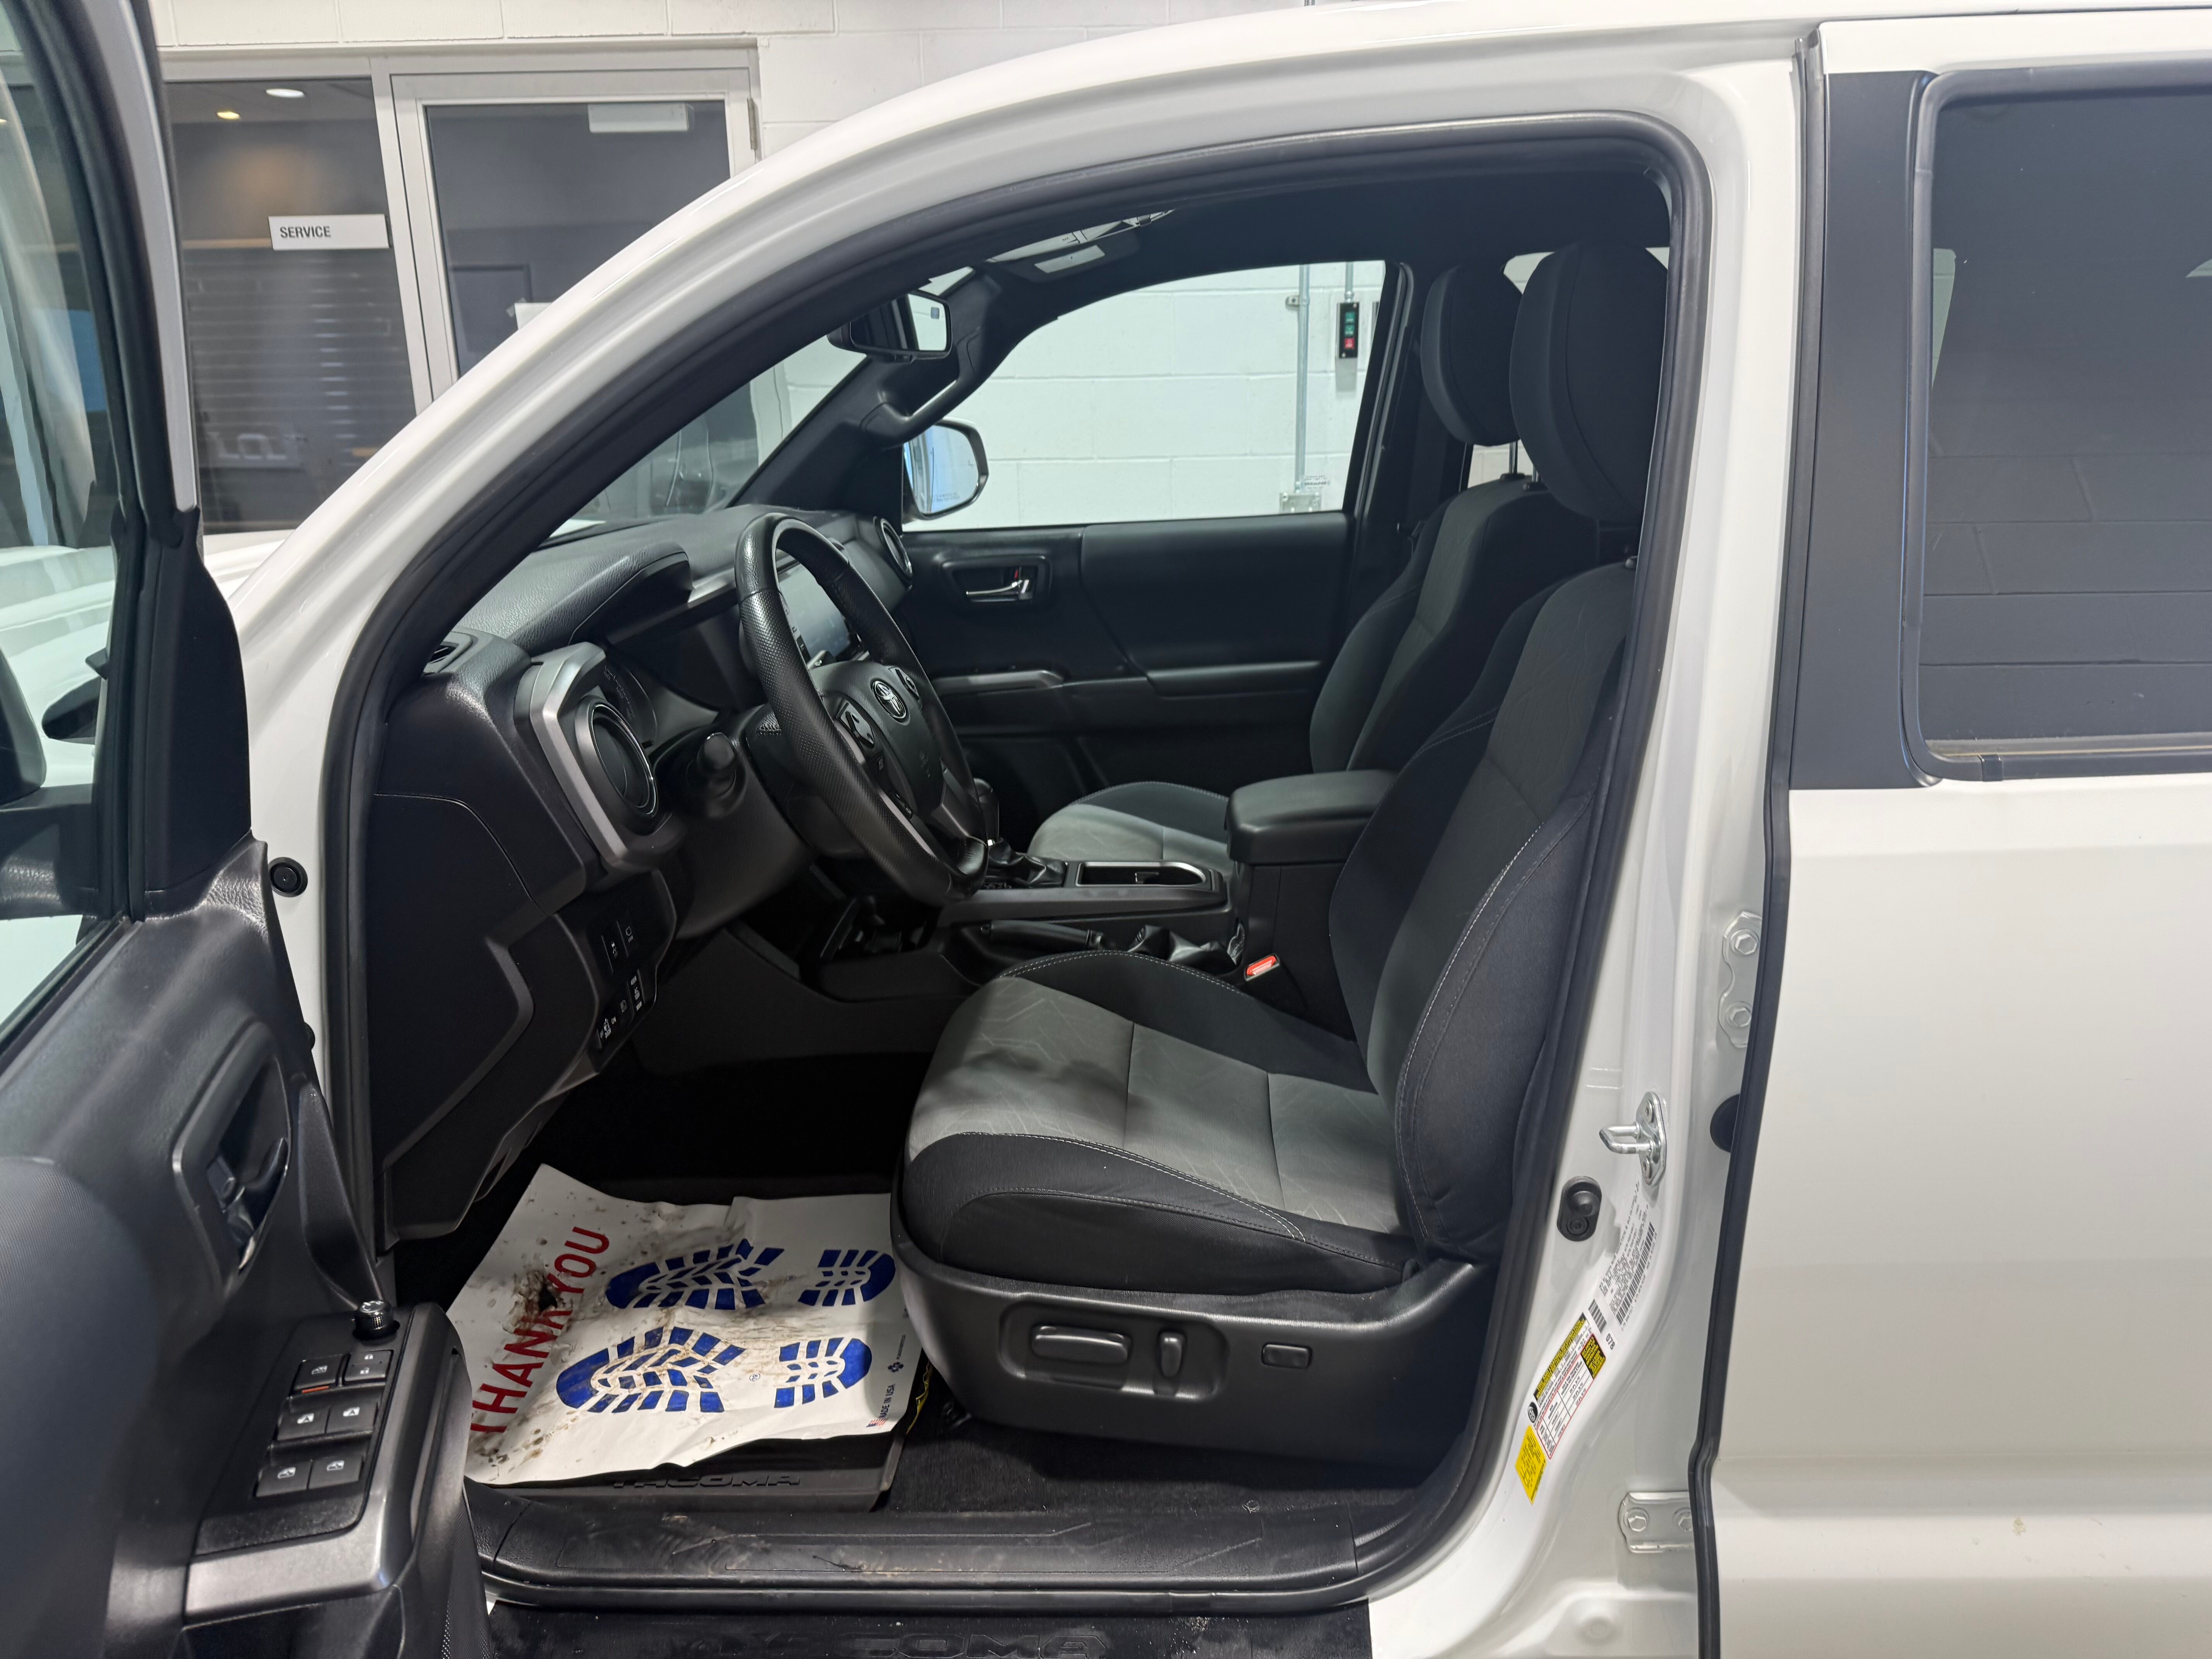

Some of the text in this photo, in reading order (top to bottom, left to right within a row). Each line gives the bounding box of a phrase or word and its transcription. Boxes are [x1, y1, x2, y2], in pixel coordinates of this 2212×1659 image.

[280, 226, 331, 238] SERVICE
[546, 1226, 610, 1294] YOU
[1606, 1333, 1615, 1350] 078
[878, 1405, 890, 1419] MADE
[886, 1384, 895, 1396] USA
